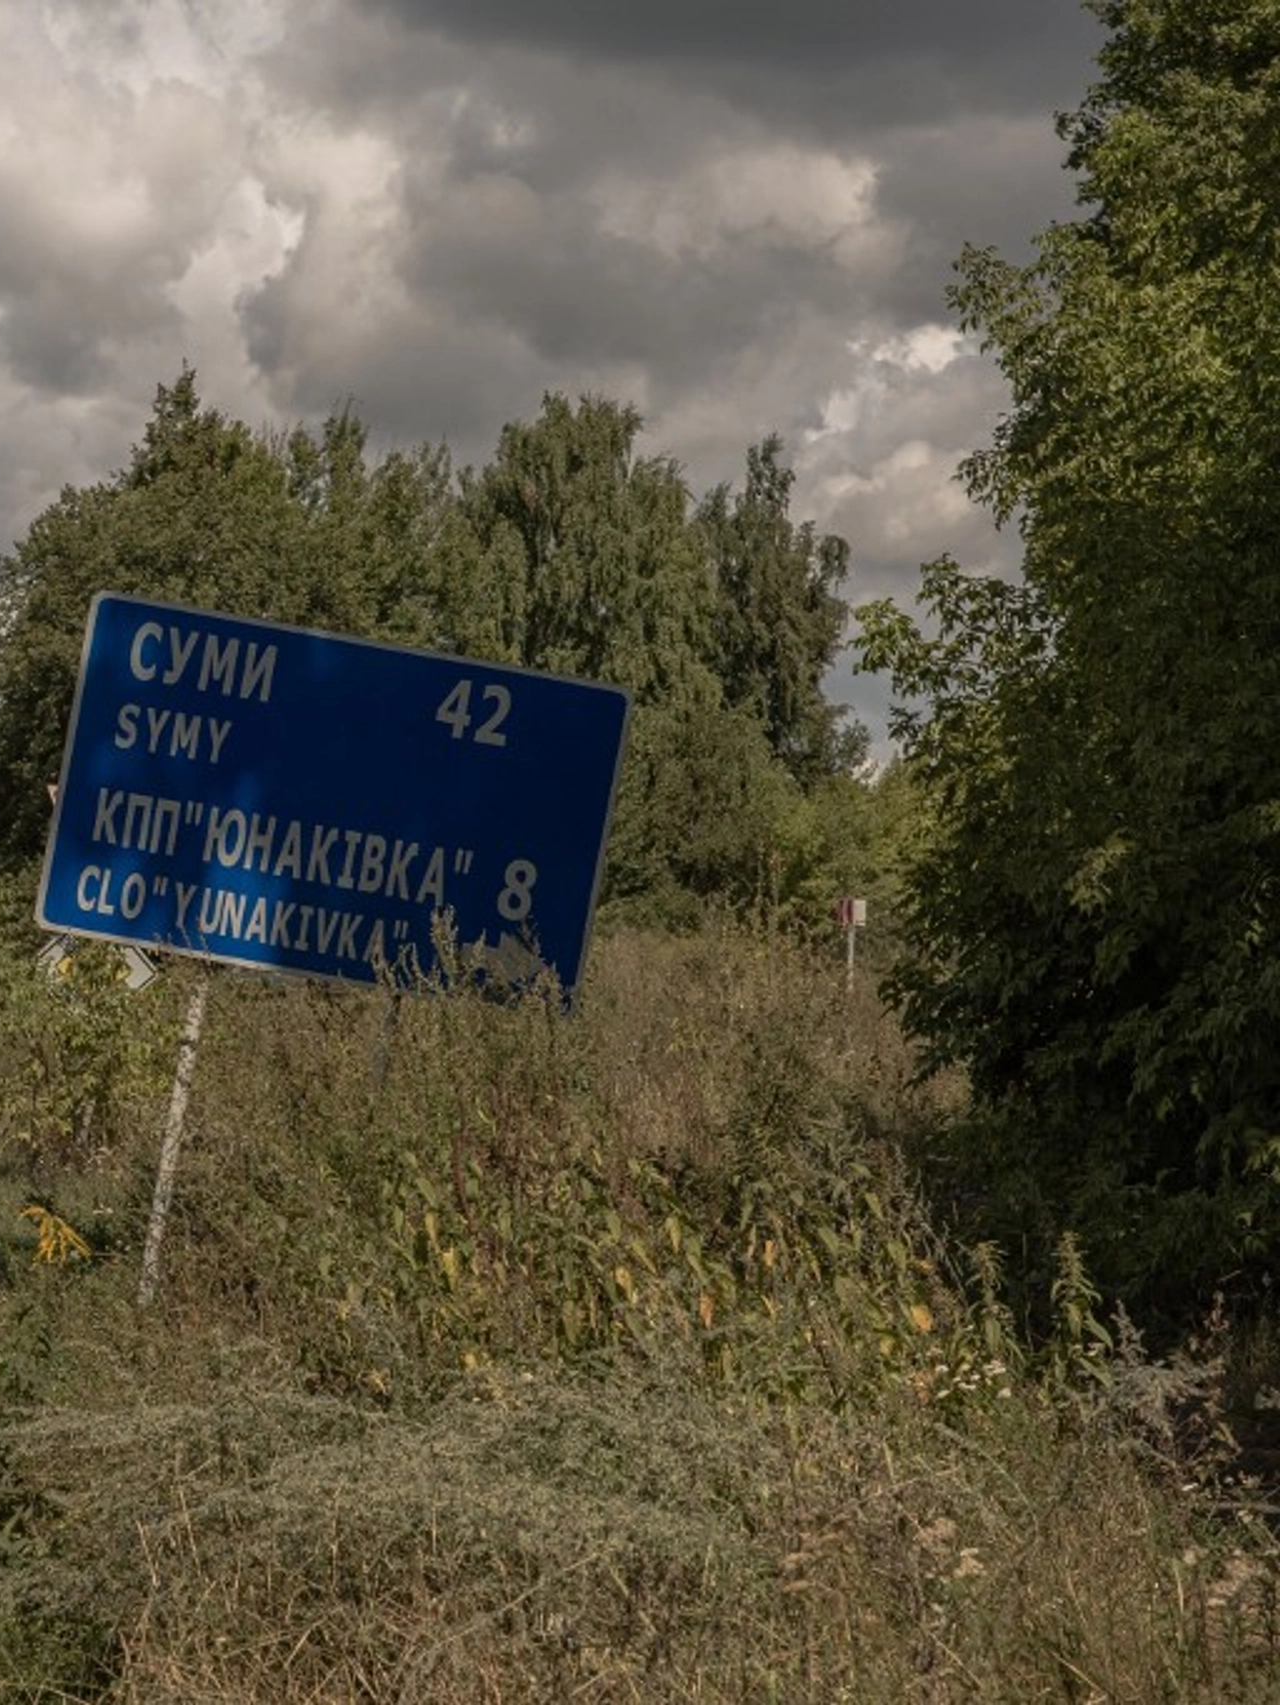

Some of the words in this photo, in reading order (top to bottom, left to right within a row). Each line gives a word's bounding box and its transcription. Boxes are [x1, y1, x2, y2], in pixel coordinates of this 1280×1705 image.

[129, 621, 278, 702] СУМИ
[435, 680, 512, 747] 42
[114, 704, 232, 764] SYMY
[497, 860, 537, 922] 8
